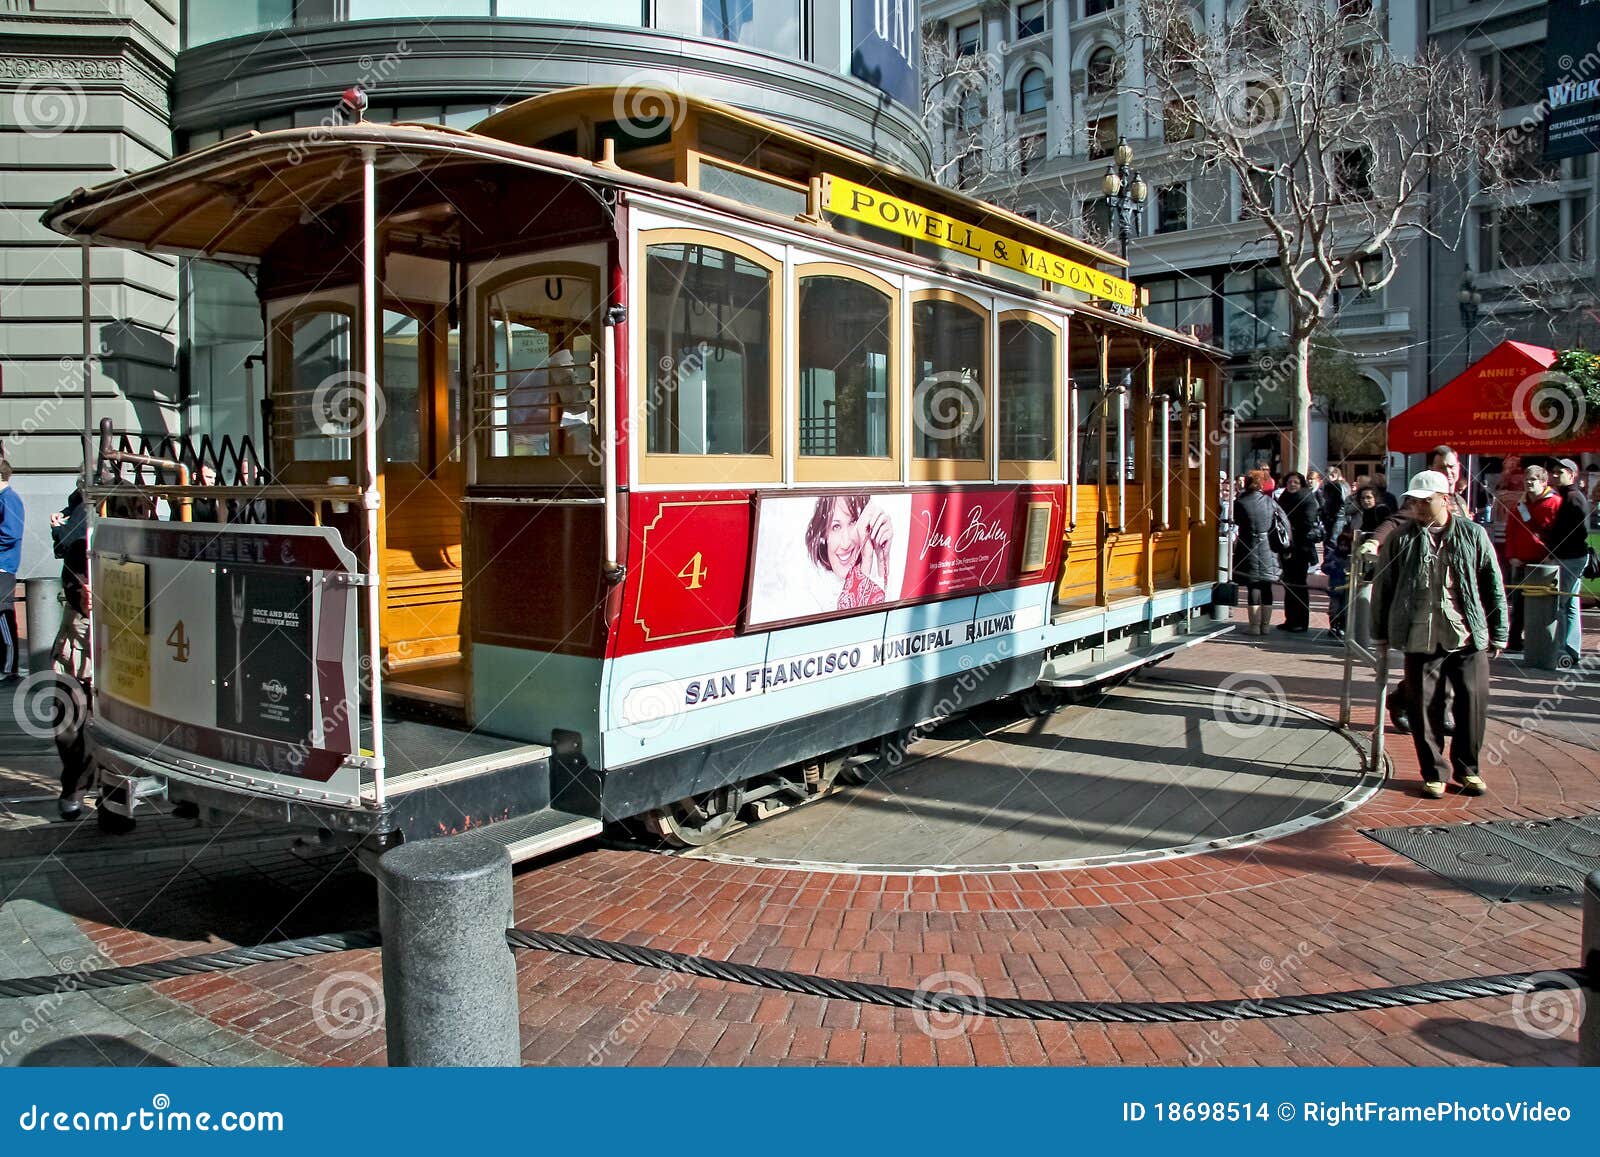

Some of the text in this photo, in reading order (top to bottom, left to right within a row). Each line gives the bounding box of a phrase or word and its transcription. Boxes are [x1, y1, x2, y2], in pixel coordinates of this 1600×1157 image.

[851, 189, 982, 252] POWELL
[993, 240, 1009, 260] &
[1019, 247, 1098, 289] MASON
[1478, 367, 1527, 379] ANNIE'S
[1468, 428, 1503, 437] SPECIAL
[1472, 411, 1527, 421] PRETZELS
[177, 534, 268, 562] STREET
[919, 498, 952, 560] Vera
[954, 505, 1011, 586] Bradley
[677, 551, 707, 589] 4
[269, 610, 283, 618] AND
[283, 611, 299, 619] ROLL
[167, 619, 190, 662] 4
[685, 614, 1017, 705] SAN FRANCISCO MUNICIPAL RAILWAY
